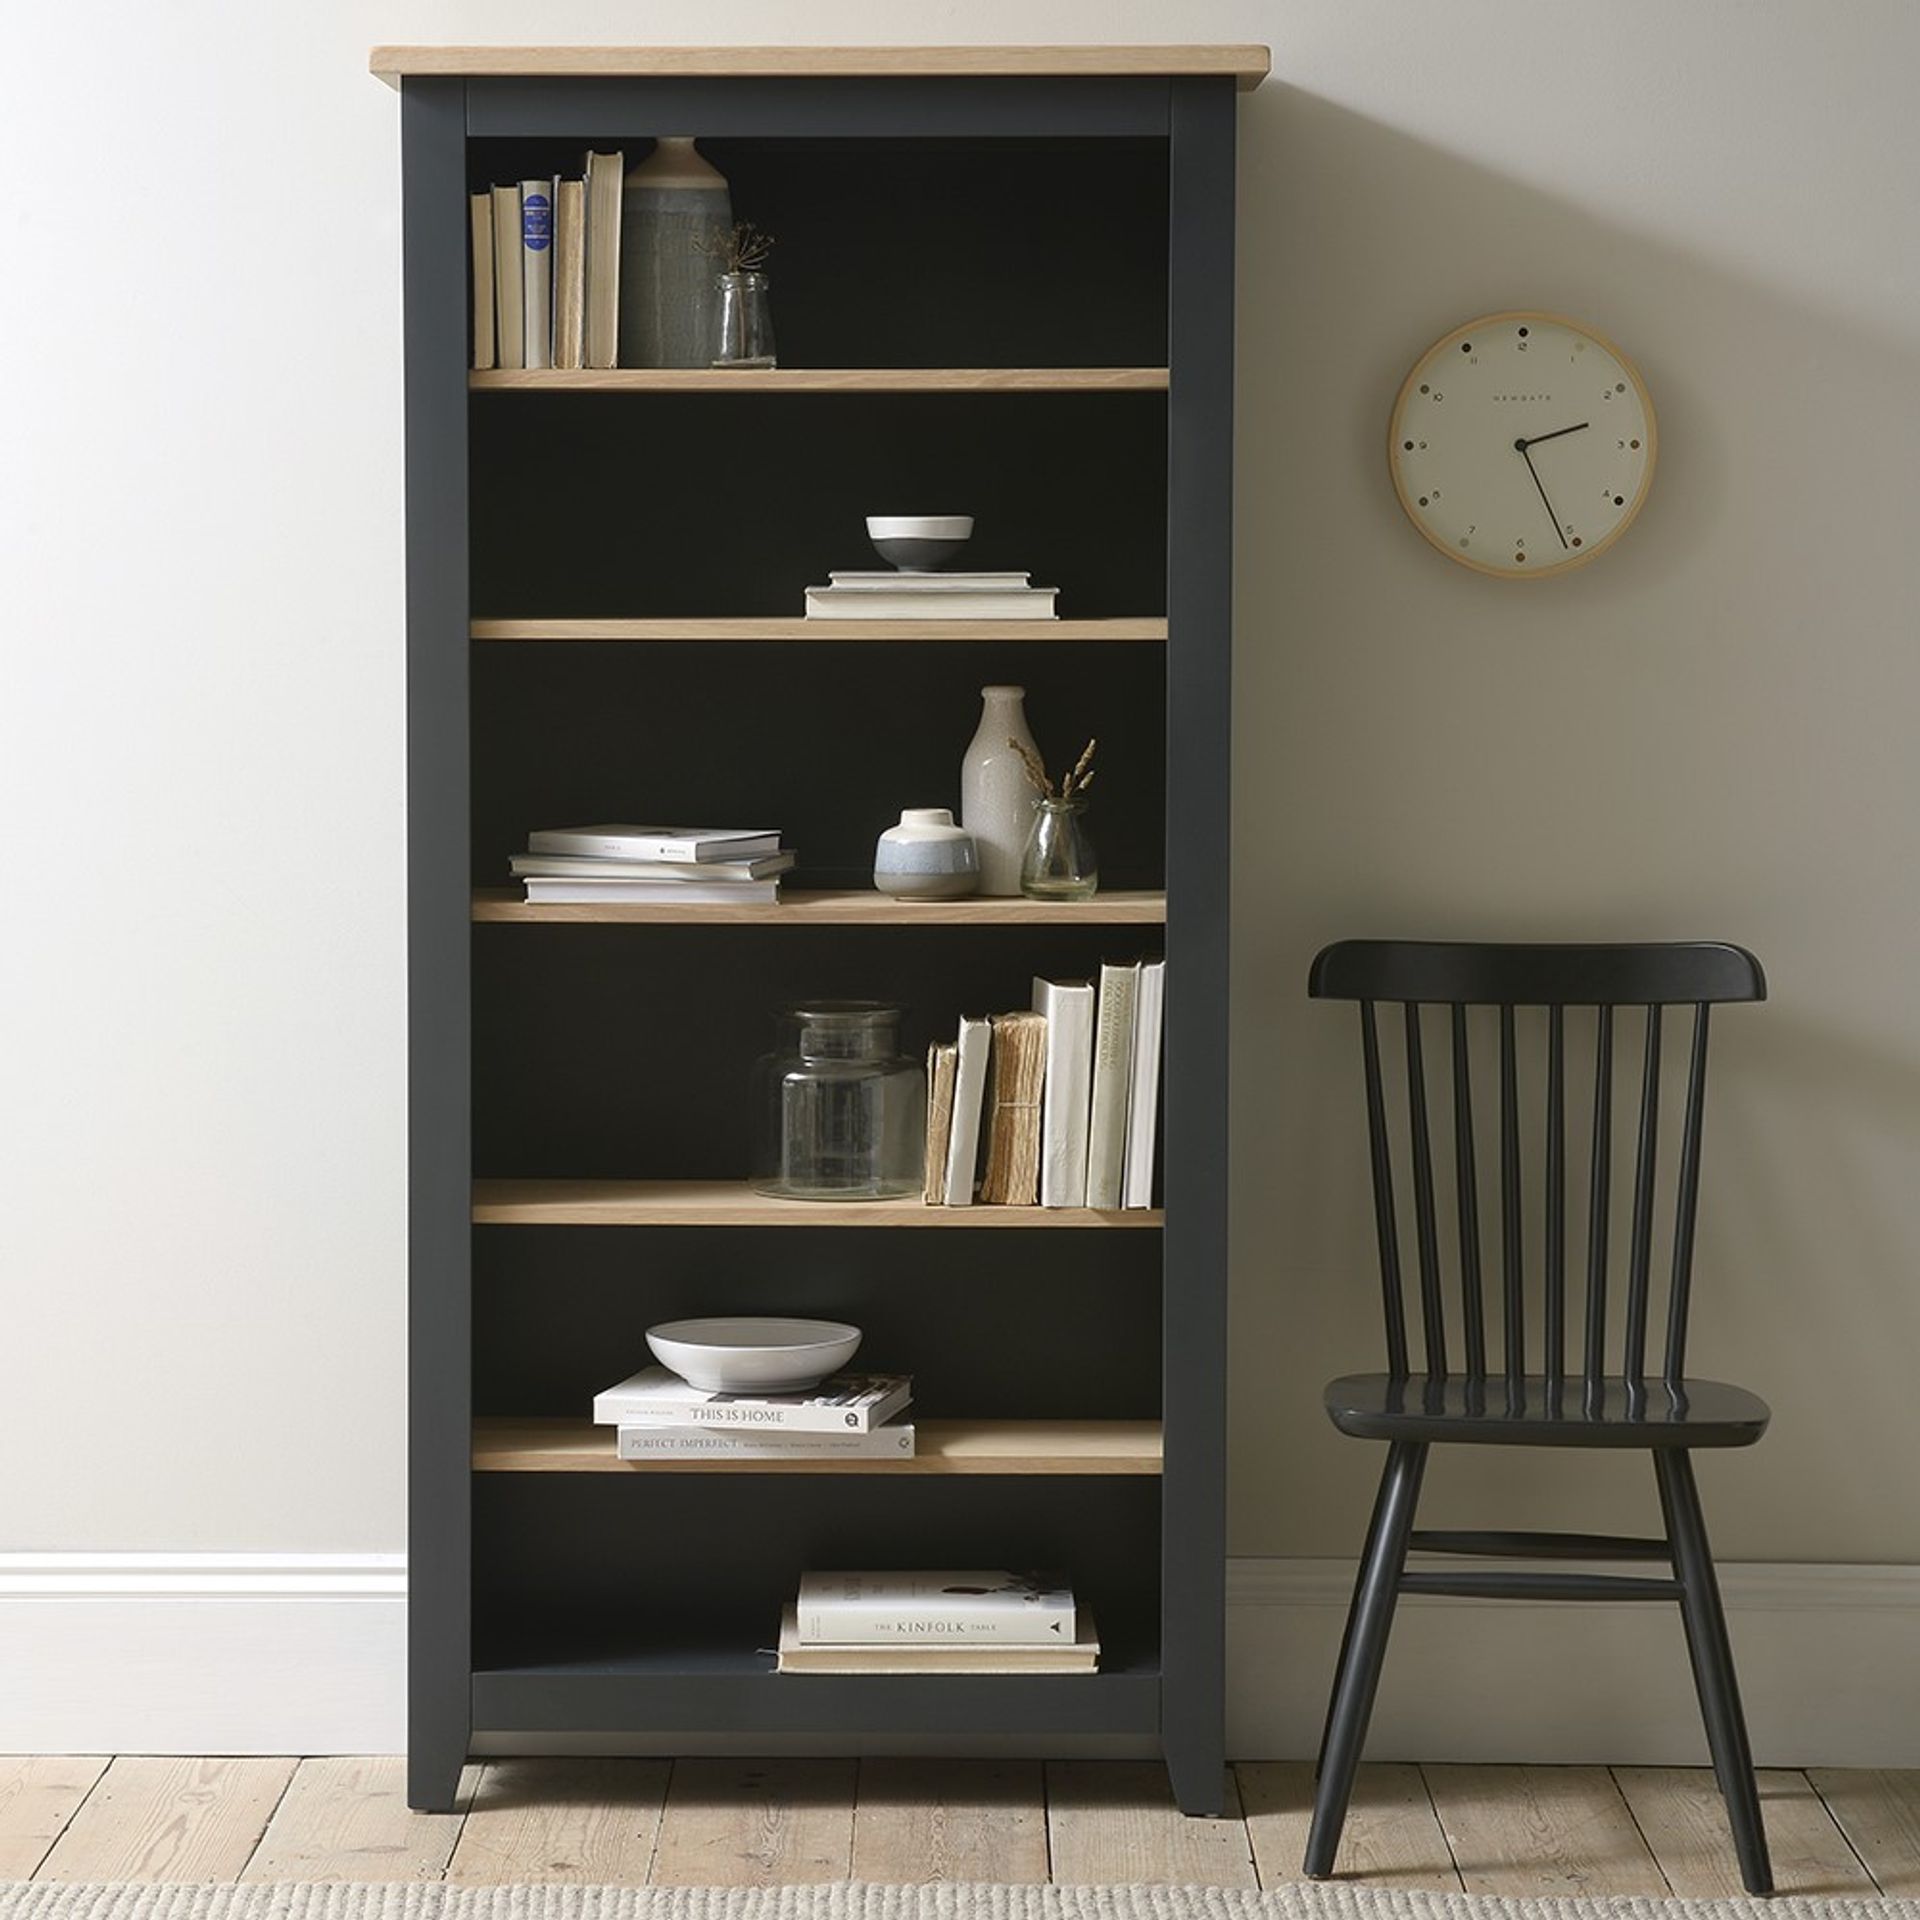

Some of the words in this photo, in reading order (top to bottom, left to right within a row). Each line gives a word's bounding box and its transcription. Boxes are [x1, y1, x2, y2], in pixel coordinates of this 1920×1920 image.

[1603, 390, 1612, 400] 2
[1616, 440, 1625, 449] 3
[690, 1408, 723, 1420] THIS
[726, 1409, 739, 1421] IS
[742, 1409, 785, 1423] HOME
[631, 1438, 675, 1448] PERFECT
[679, 1438, 737, 1448] IMPERFECT
[896, 1622, 965, 1633] KINFOLK
